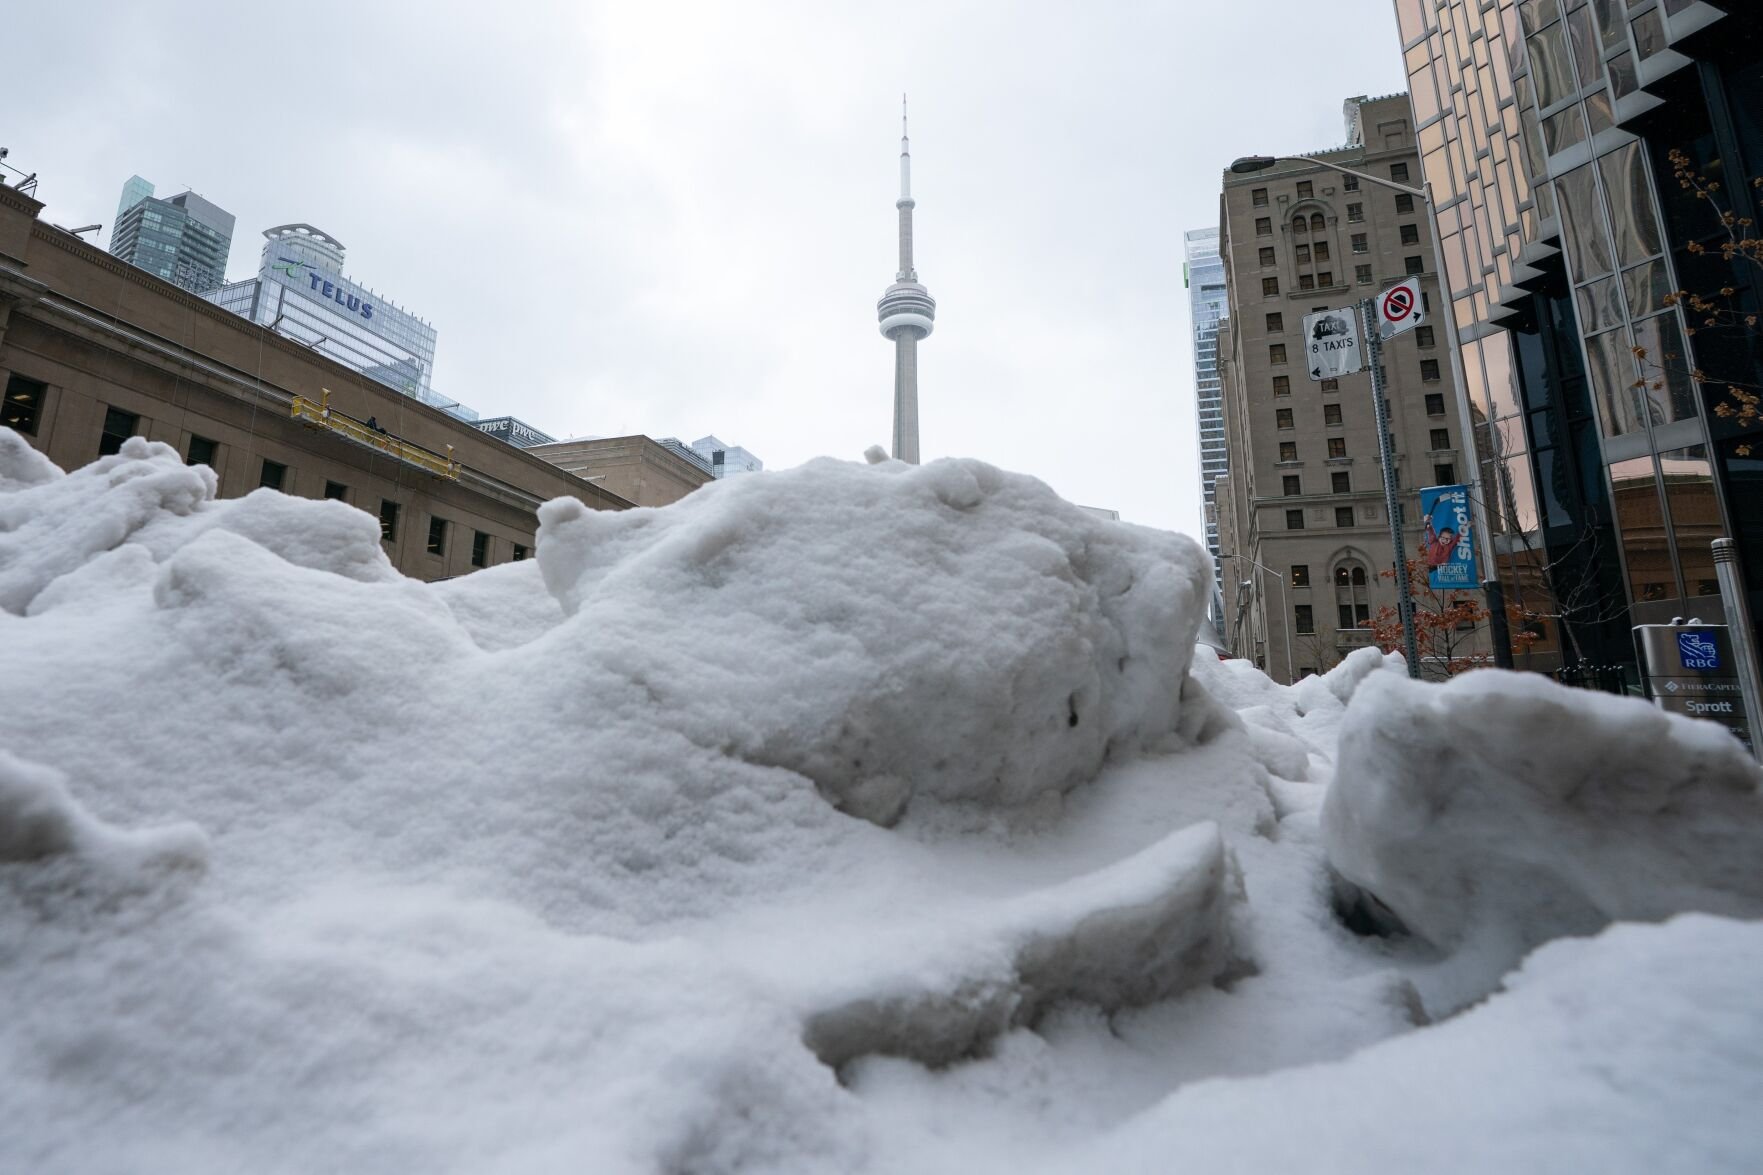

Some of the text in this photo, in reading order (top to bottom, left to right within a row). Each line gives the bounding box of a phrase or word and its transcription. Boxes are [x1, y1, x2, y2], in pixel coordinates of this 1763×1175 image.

[309, 272, 373, 319] TELUS
[1312, 344, 1319, 353] 8
[512, 421, 535, 440] pwc
[1450, 491, 1472, 560] Shoot it
[1437, 564, 1468, 575] HOCKEY
[1685, 659, 1718, 668] RBC
[1686, 701, 1733, 714] Sprott
